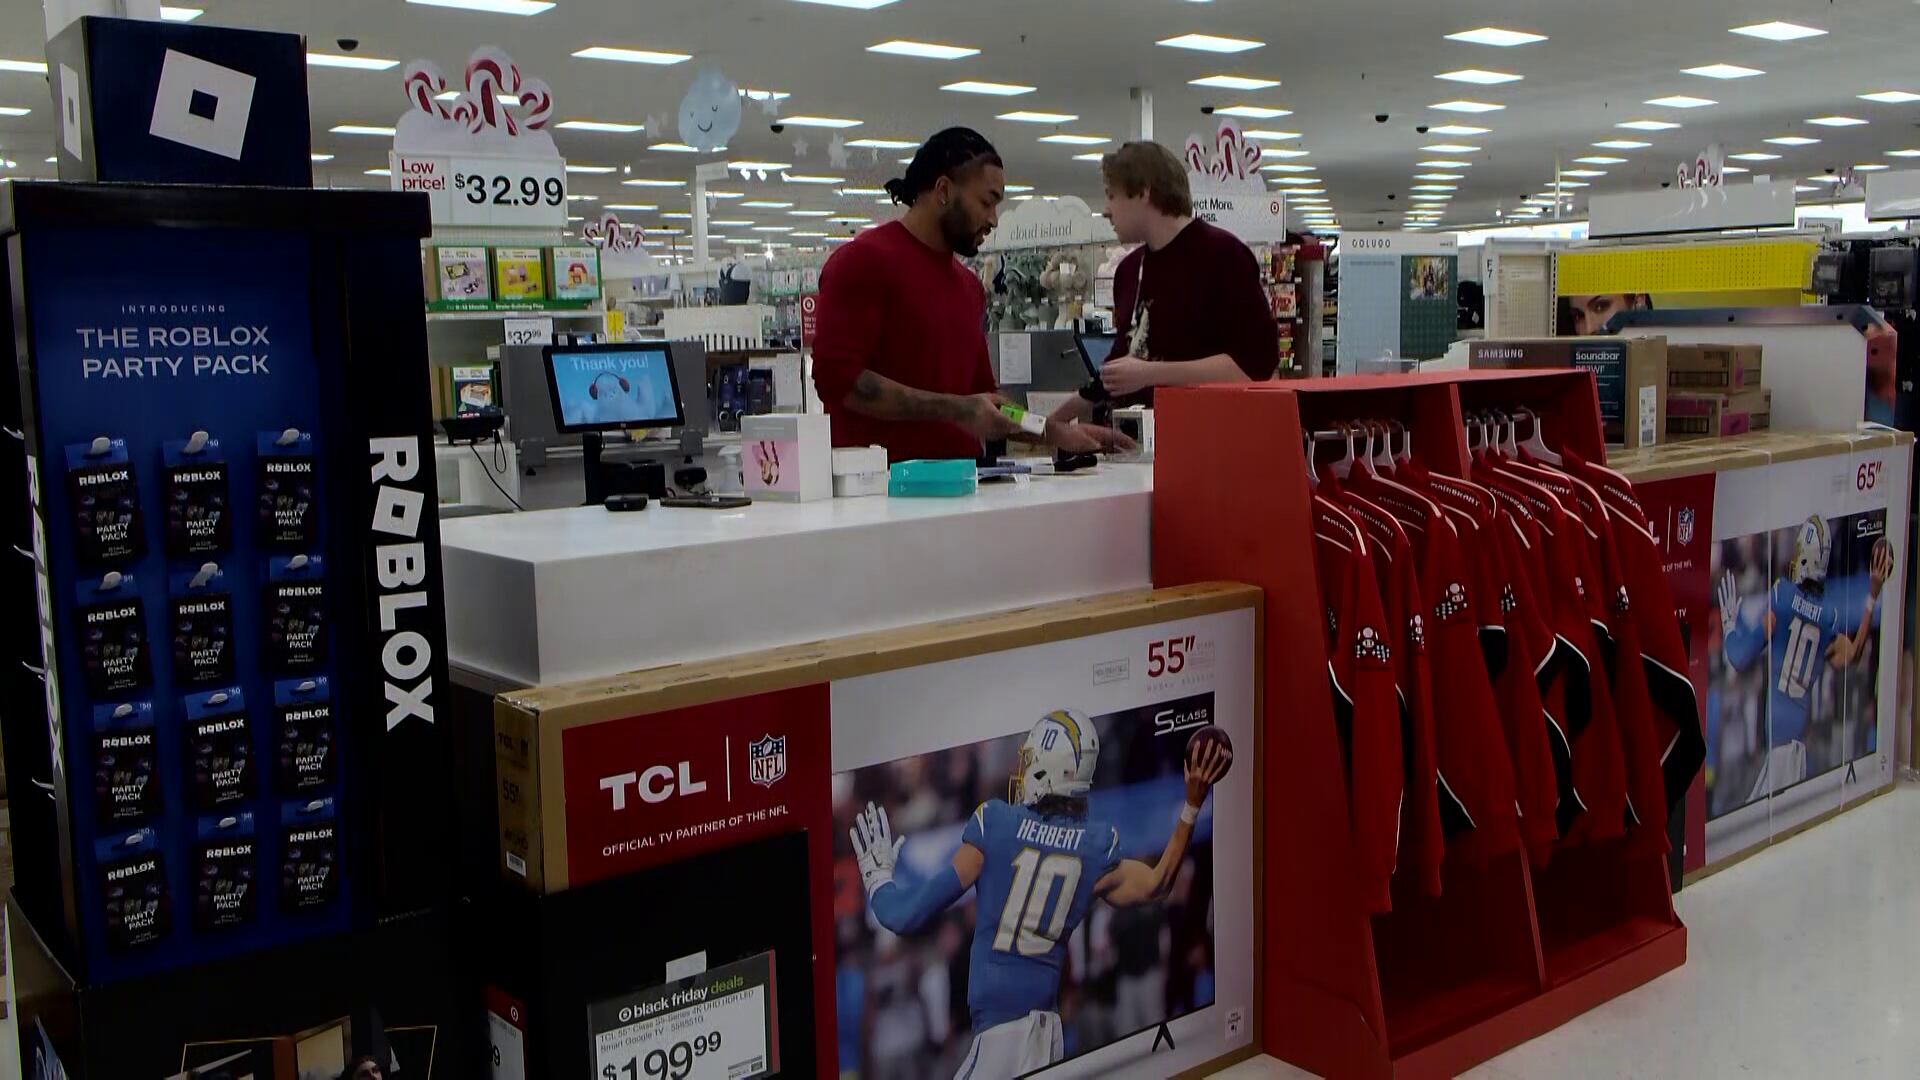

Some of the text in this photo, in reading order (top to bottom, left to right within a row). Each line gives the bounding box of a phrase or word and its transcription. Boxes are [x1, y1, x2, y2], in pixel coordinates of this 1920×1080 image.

[401, 159, 434, 175] Low
[402, 173, 563, 206] price! $32.99
[1210, 198, 1233, 210] More.
[1010, 220, 1072, 241] cloud island
[121, 304, 225, 313] INTRODUCING
[76, 325, 270, 349] THE ROBLOX
[1478, 349, 1524, 358] SAMSUNG
[1575, 351, 1620, 360] Soundbar
[83, 355, 270, 379] PARTY PACK
[571, 354, 650, 373] Thank you!
[267, 463, 311, 472] ROBLOX
[79, 471, 129, 486] ROBLOX
[174, 471, 221, 483] ROBLOX
[1857, 460, 1882, 490] 65"
[275, 510, 304, 519] PARTY
[186, 519, 217, 529] PARTY
[278, 518, 302, 526] PACK
[96, 523, 129, 534] PARTY
[190, 527, 215, 536] PACK
[101, 532, 128, 542] PACK
[369, 434, 435, 732] ROBLOX
[279, 586, 322, 597] ROBLOX
[179, 601, 225, 614] ROBLOX
[1791, 593, 1823, 623] HERBERT
[88, 607, 136, 623] ROBLOX
[287, 633, 315, 641] PARTY
[289, 640, 312, 648] PACK
[191, 648, 221, 659] PARTY
[1148, 635, 1195, 679] 55"
[1777, 617, 1821, 699] 10
[103, 655, 135, 668] PARTY
[194, 657, 218, 667] PACK
[107, 665, 133, 676] PACK
[285, 707, 329, 722] ROBLOX
[198, 719, 245, 735] ROBLOX
[102, 735, 151, 748] ROBLOX
[1041, 727, 1059, 751] 10
[296, 754, 325, 765] PARTY
[299, 763, 322, 772] PACK
[212, 768, 242, 781] PARTY
[215, 777, 240, 787] PACK
[600, 761, 706, 812] TCL
[112, 784, 144, 795] PARTY
[115, 793, 141, 803] PACK
[290, 829, 333, 842] ROBLOX
[602, 805, 789, 857] OFFICIAL TV PARTNER OF THE NFL
[1017, 818, 1085, 851] HERBERT
[207, 845, 251, 858] ROBLOX
[107, 861, 156, 880] ROBLOX
[297, 875, 326, 884] PARTY
[300, 882, 323, 892] PACK
[214, 891, 244, 902] PARTY
[992, 846, 1083, 957] 10
[217, 900, 240, 910] PACK
[124, 909, 156, 923] PARTY
[129, 918, 154, 930] PACK
[633, 974, 744, 1018] black friday deals
[654, 1028, 664, 1038] TV
